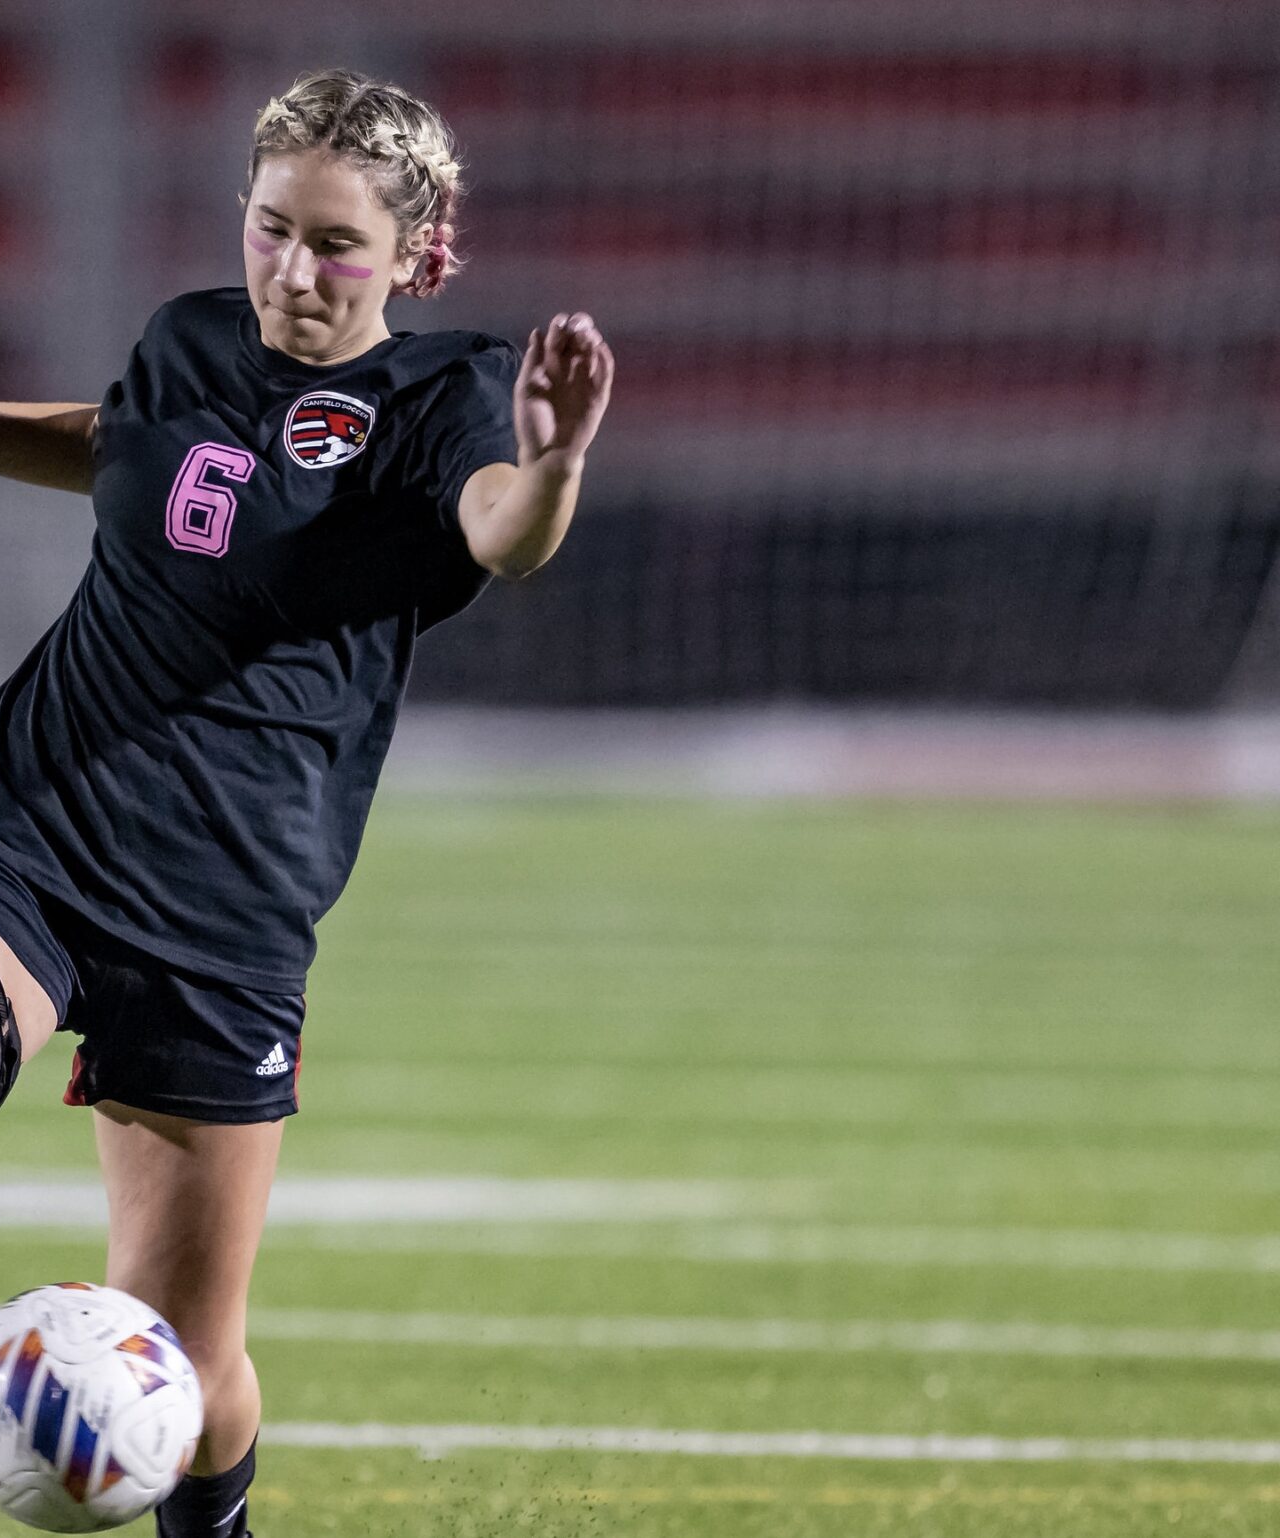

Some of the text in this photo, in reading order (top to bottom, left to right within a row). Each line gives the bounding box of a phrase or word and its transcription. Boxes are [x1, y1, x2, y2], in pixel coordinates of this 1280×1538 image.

[303, 400, 369, 420] CANFIELD SOCCER
[165, 441, 257, 558] 6
[256, 1061, 289, 1076] adidas
